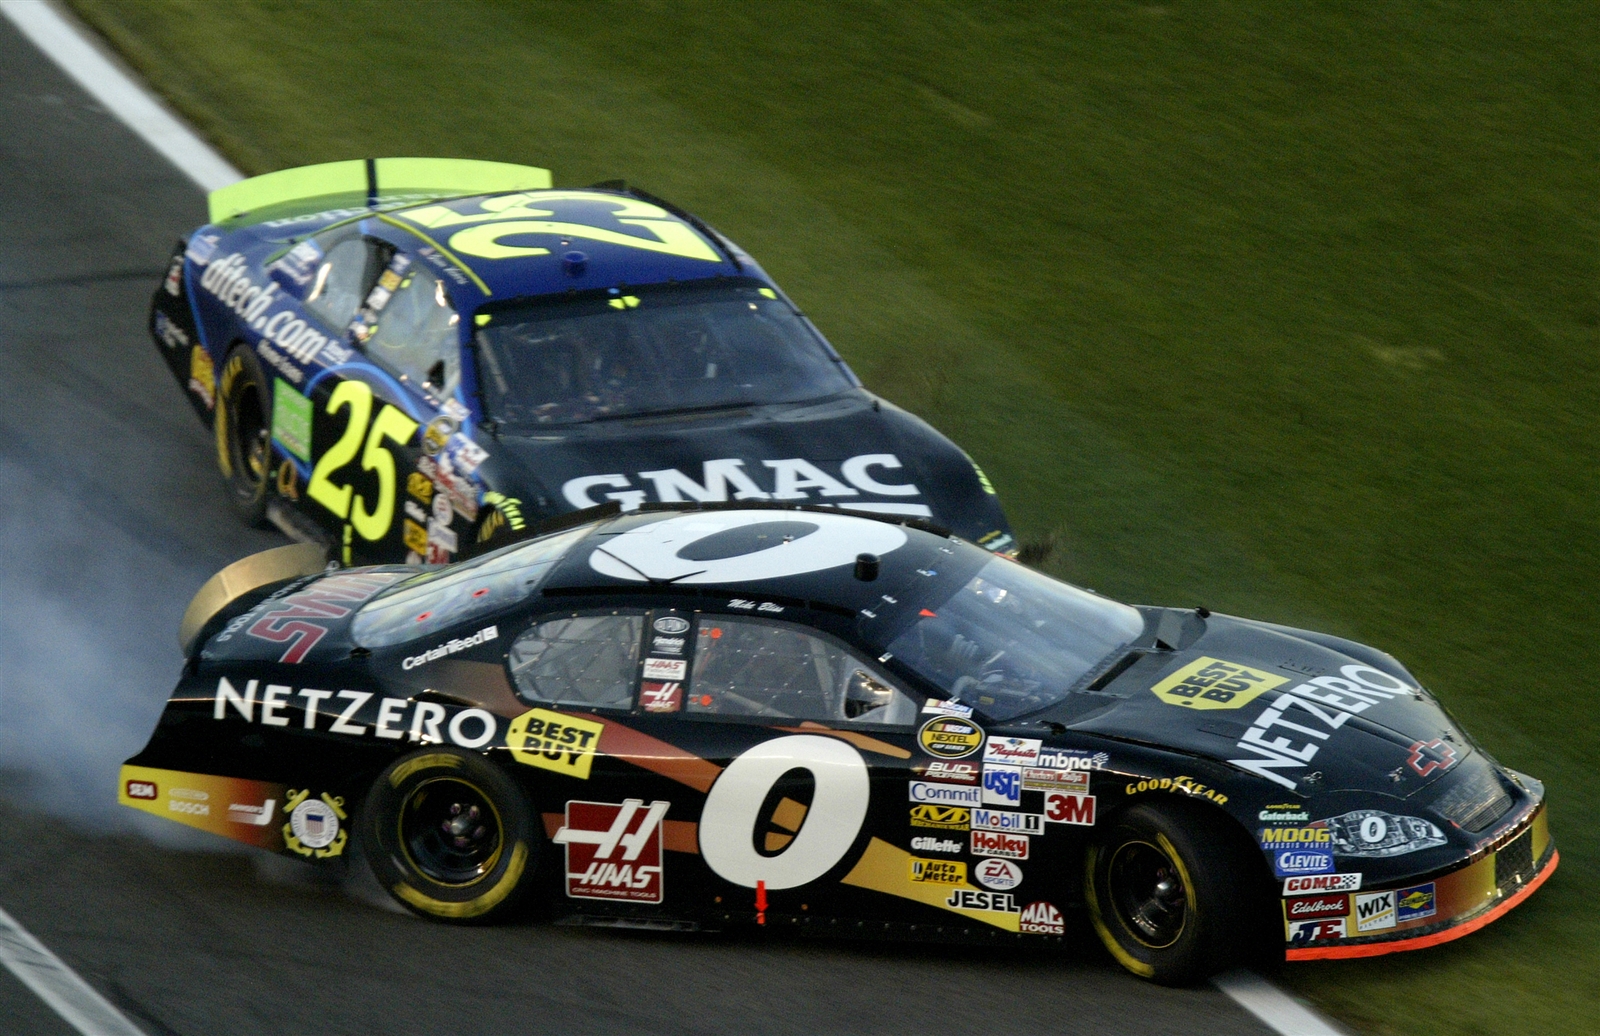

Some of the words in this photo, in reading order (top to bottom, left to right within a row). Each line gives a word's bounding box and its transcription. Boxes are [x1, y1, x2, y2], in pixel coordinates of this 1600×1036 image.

[399, 190, 723, 263] 25
[201, 252, 328, 365] ditech.com
[307, 381, 418, 541] 25
[562, 453, 922, 512] GMAC
[589, 509, 908, 583] 0
[402, 630, 483, 670] CertainTeed
[1167, 661, 1240, 698] BEST
[1200, 670, 1266, 704] BUY
[213, 676, 497, 749] NETZERO
[525, 717, 596, 748] BEST
[932, 733, 969, 743] NEXTEL
[1226, 664, 1409, 790] NETZERO
[521, 736, 587, 766] BUY
[1039, 753, 1092, 770] mbna
[928, 762, 972, 774] BUD
[911, 783, 980, 802] Commit
[984, 770, 1019, 801] USG
[1125, 776, 1229, 805] GOODYEAR
[699, 734, 870, 889] 0
[975, 810, 1020, 829] Mobil
[1046, 794, 1094, 824] 3M
[1259, 810, 1310, 821] Gatorback
[1261, 828, 1330, 843] MOOG
[1360, 816, 1387, 843] 0
[910, 836, 962, 853] Gillette
[973, 832, 1027, 858] Holley
[926, 862, 957, 873] Auto
[984, 861, 1014, 878] EA
[1280, 852, 1329, 868] CLEVITE
[567, 862, 662, 888] HAAS
[924, 871, 963, 883] Meter
[983, 876, 1015, 886] SPORTS
[1288, 875, 1342, 892] COMP
[947, 890, 1020, 913] JESEL
[1021, 902, 1064, 925] MAC
[1291, 899, 1345, 914] Edelbrock
[1357, 892, 1391, 919] WIX
[1021, 923, 1065, 934] TOOLS
